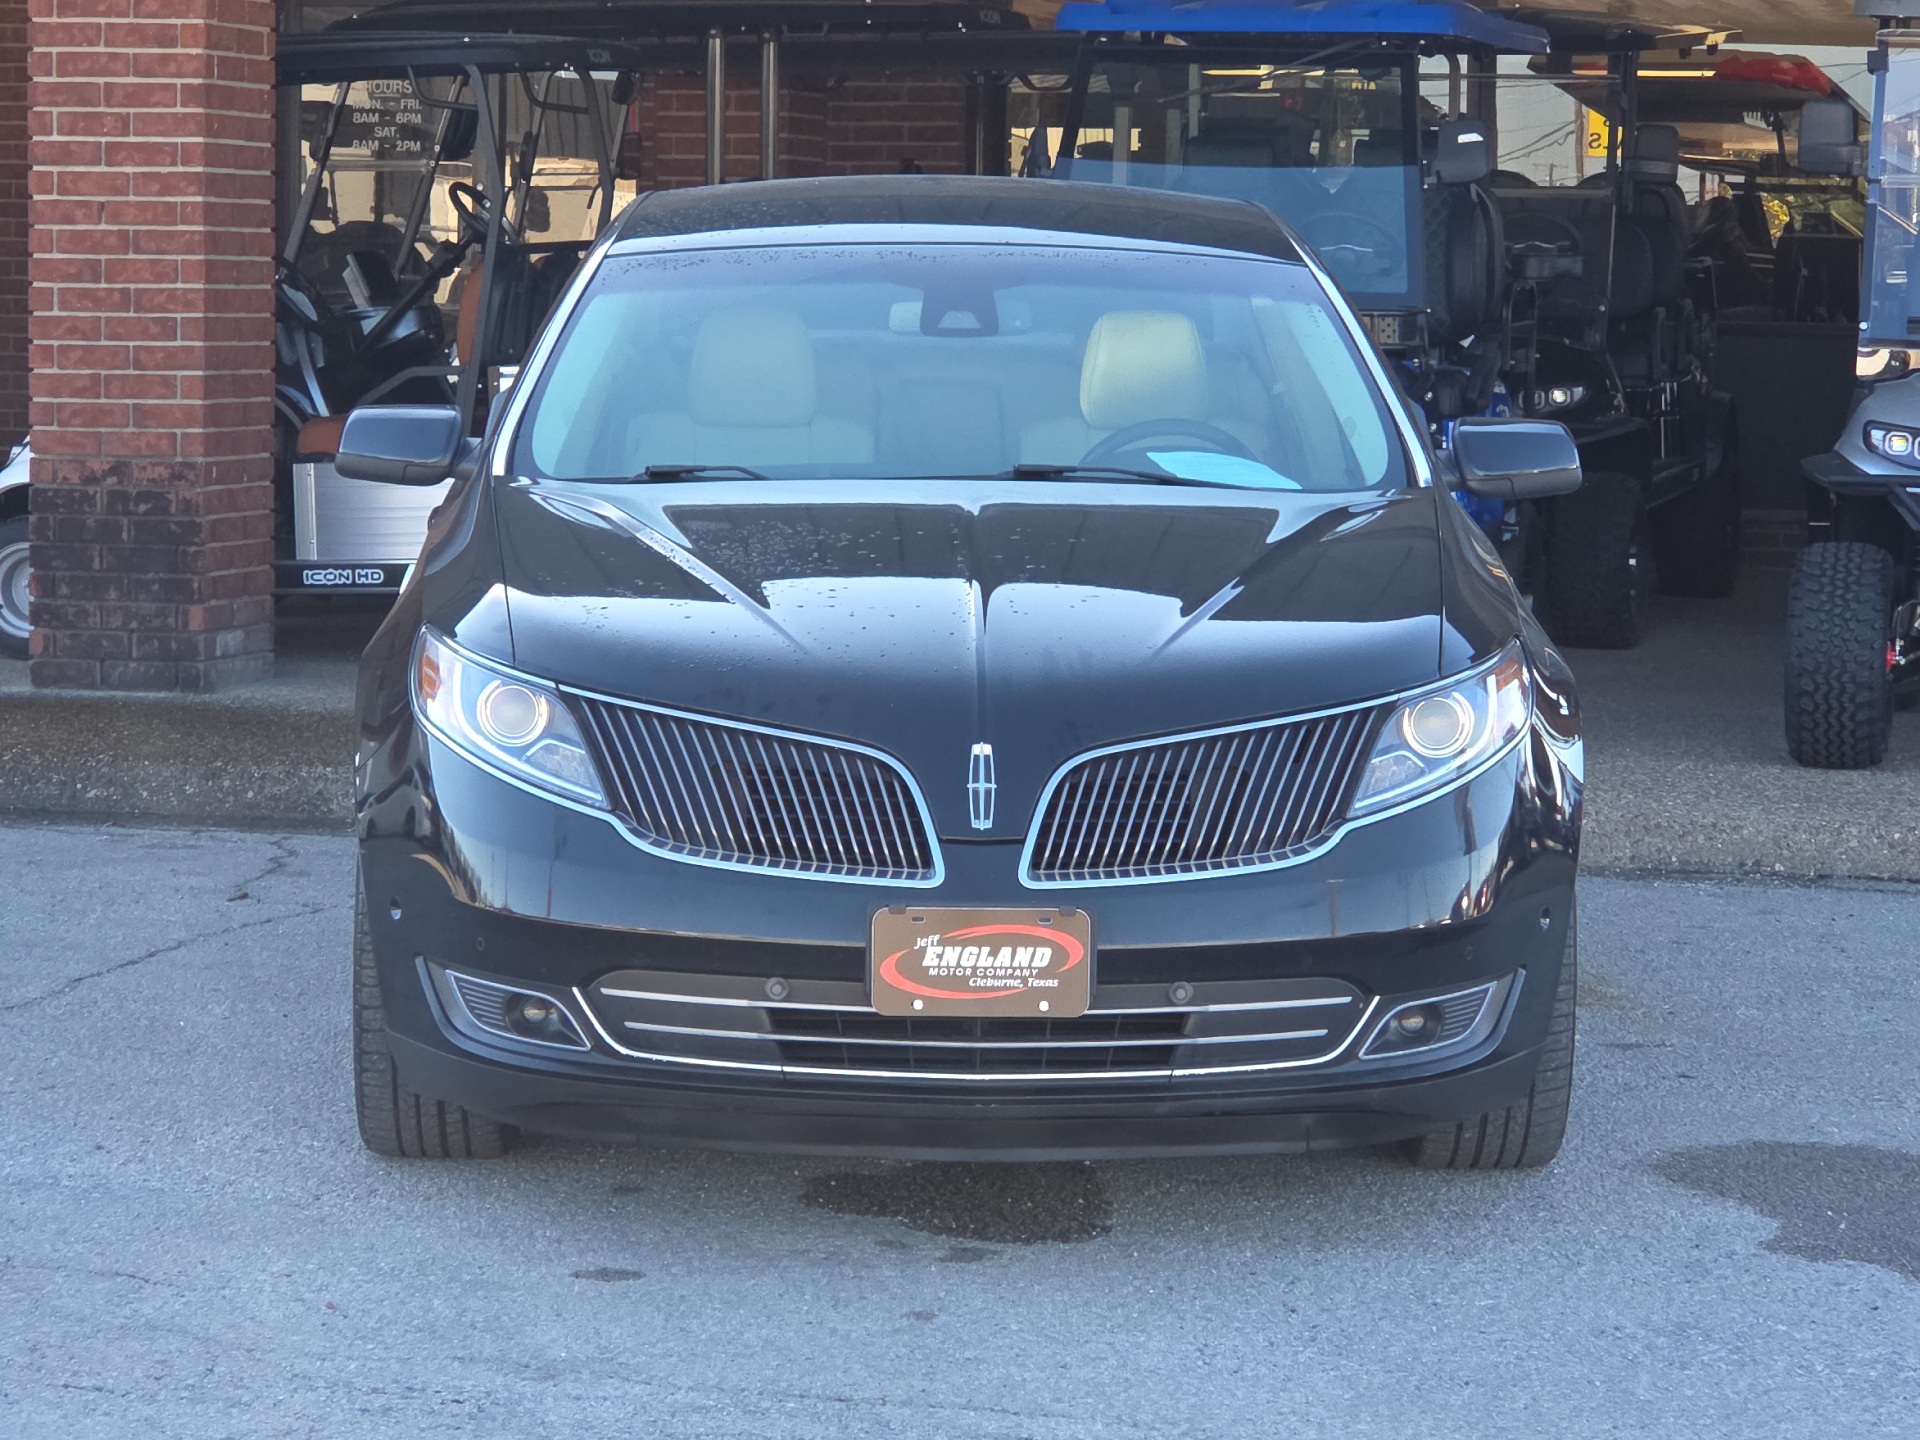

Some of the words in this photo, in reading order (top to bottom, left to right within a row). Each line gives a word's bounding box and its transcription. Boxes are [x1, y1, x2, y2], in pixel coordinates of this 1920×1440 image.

[400, 99, 422, 110] FRI.
[352, 112, 379, 124] 8AM
[395, 112, 422, 124] 6PM
[374, 126, 400, 138] SAT.
[352, 139, 379, 151] 8AM
[395, 140, 421, 152] 2PM
[303, 568, 352, 585] ICON
[355, 569, 384, 584] HD
[914, 935, 940, 950] Jeff
[922, 946, 1052, 968] ENGLAND
[929, 967, 972, 976] MOTOR
[976, 968, 1039, 977] COMPANY
[969, 977, 1023, 988] Cleburne,
[1027, 977, 1060, 988] Texas
